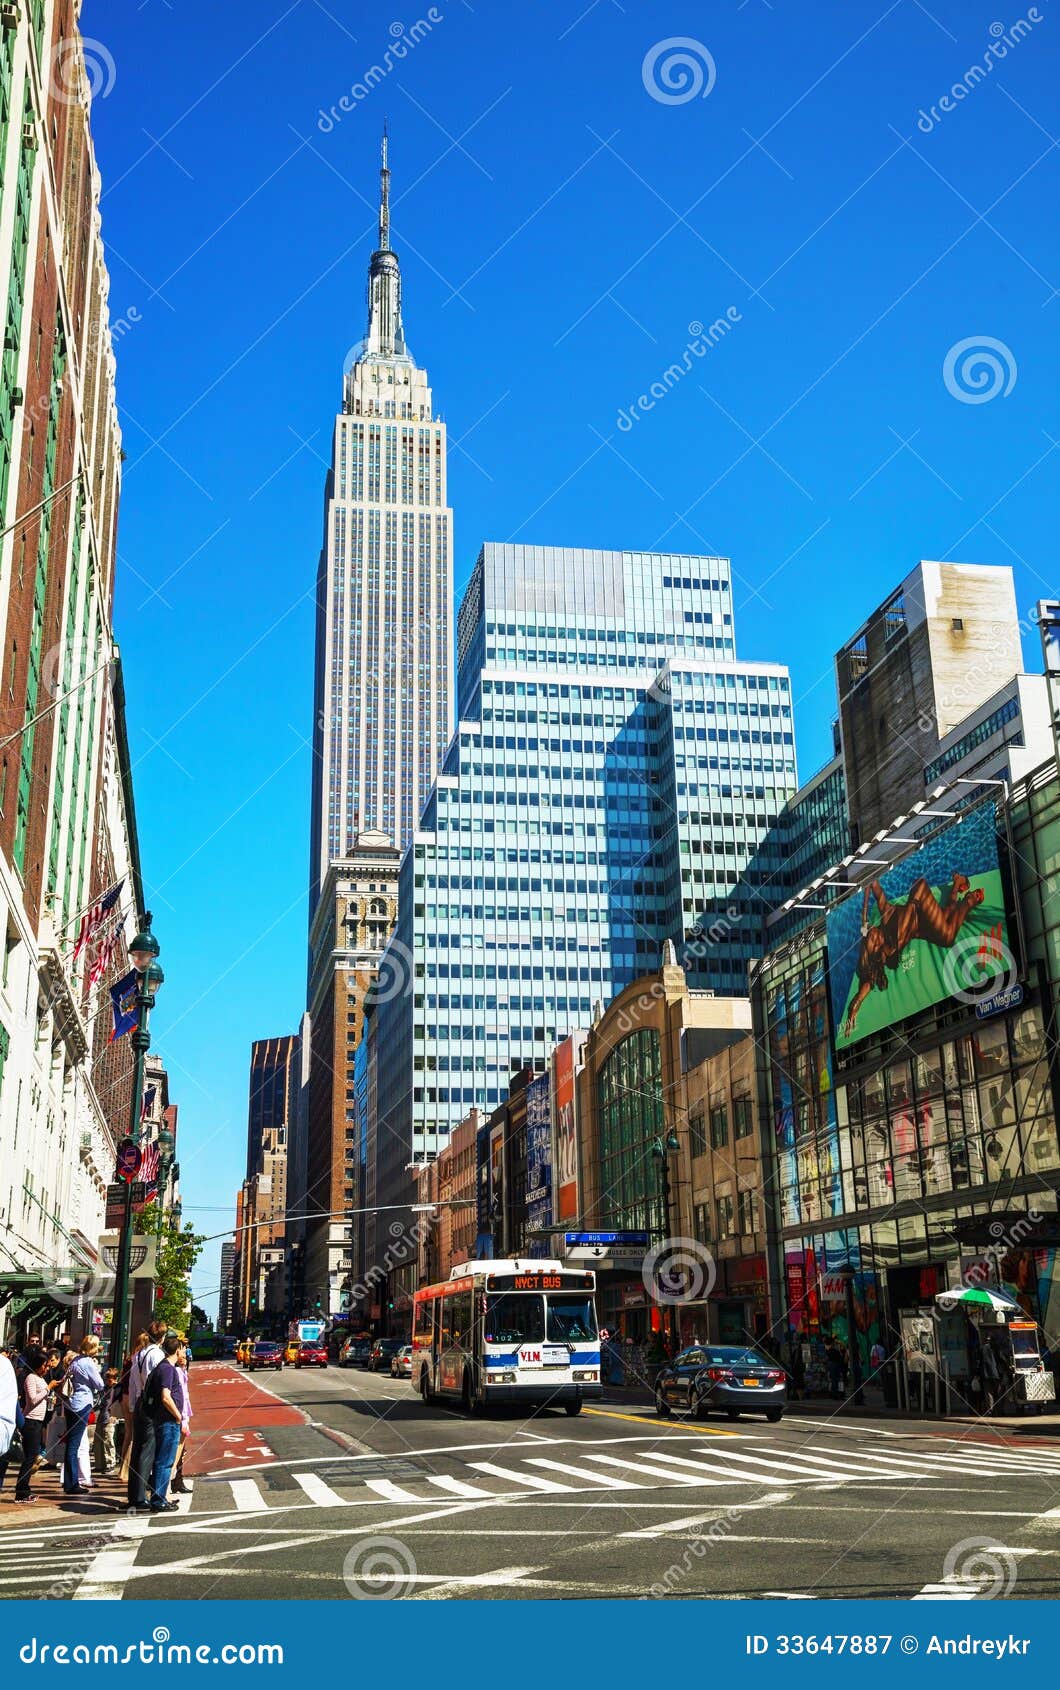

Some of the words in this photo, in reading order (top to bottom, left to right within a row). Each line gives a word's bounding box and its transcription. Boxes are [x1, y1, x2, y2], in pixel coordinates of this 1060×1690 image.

[979, 1002, 993, 1015] Van
[515, 1277, 540, 1289] NYCT
[542, 1276, 562, 1288] BUS
